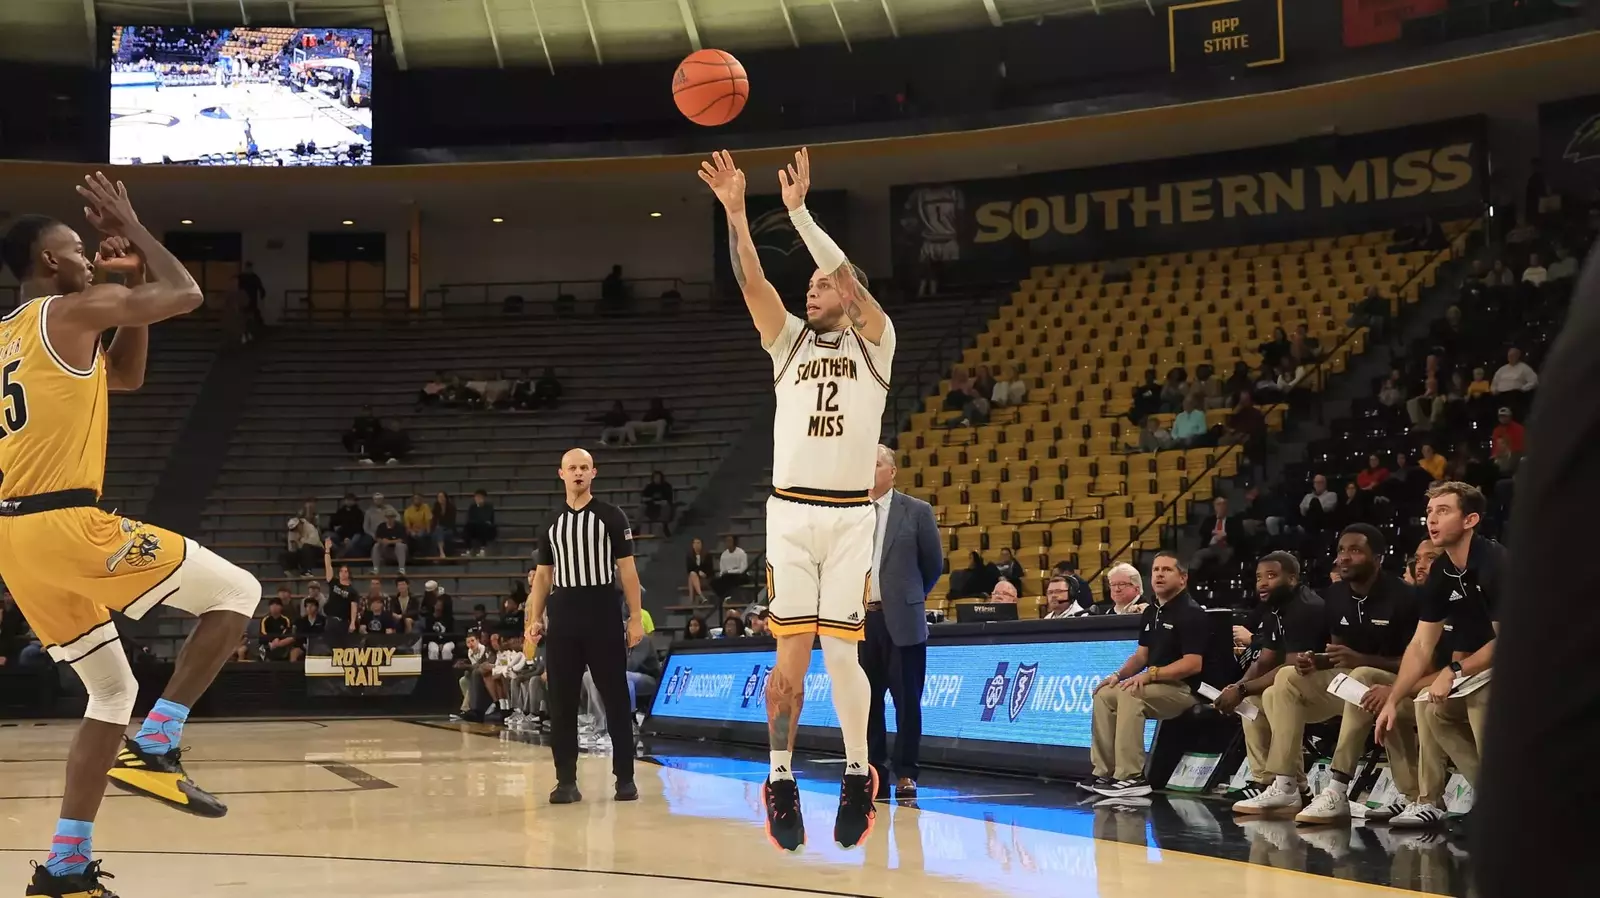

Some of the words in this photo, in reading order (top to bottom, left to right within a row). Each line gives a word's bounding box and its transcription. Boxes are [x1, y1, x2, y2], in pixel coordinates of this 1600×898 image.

[1212, 17, 1240, 34] APP
[1203, 34, 1250, 53] STATE
[974, 168, 1305, 243] SOUTHERN
[1318, 143, 1474, 208] MISS
[795, 356, 858, 386] SOUTHERN
[816, 380, 839, 412] 12
[807, 414, 844, 437] MISS
[332, 646, 396, 667] ROWDY
[344, 666, 383, 687] RAIL
[684, 673, 736, 699] MISSISSIPPI
